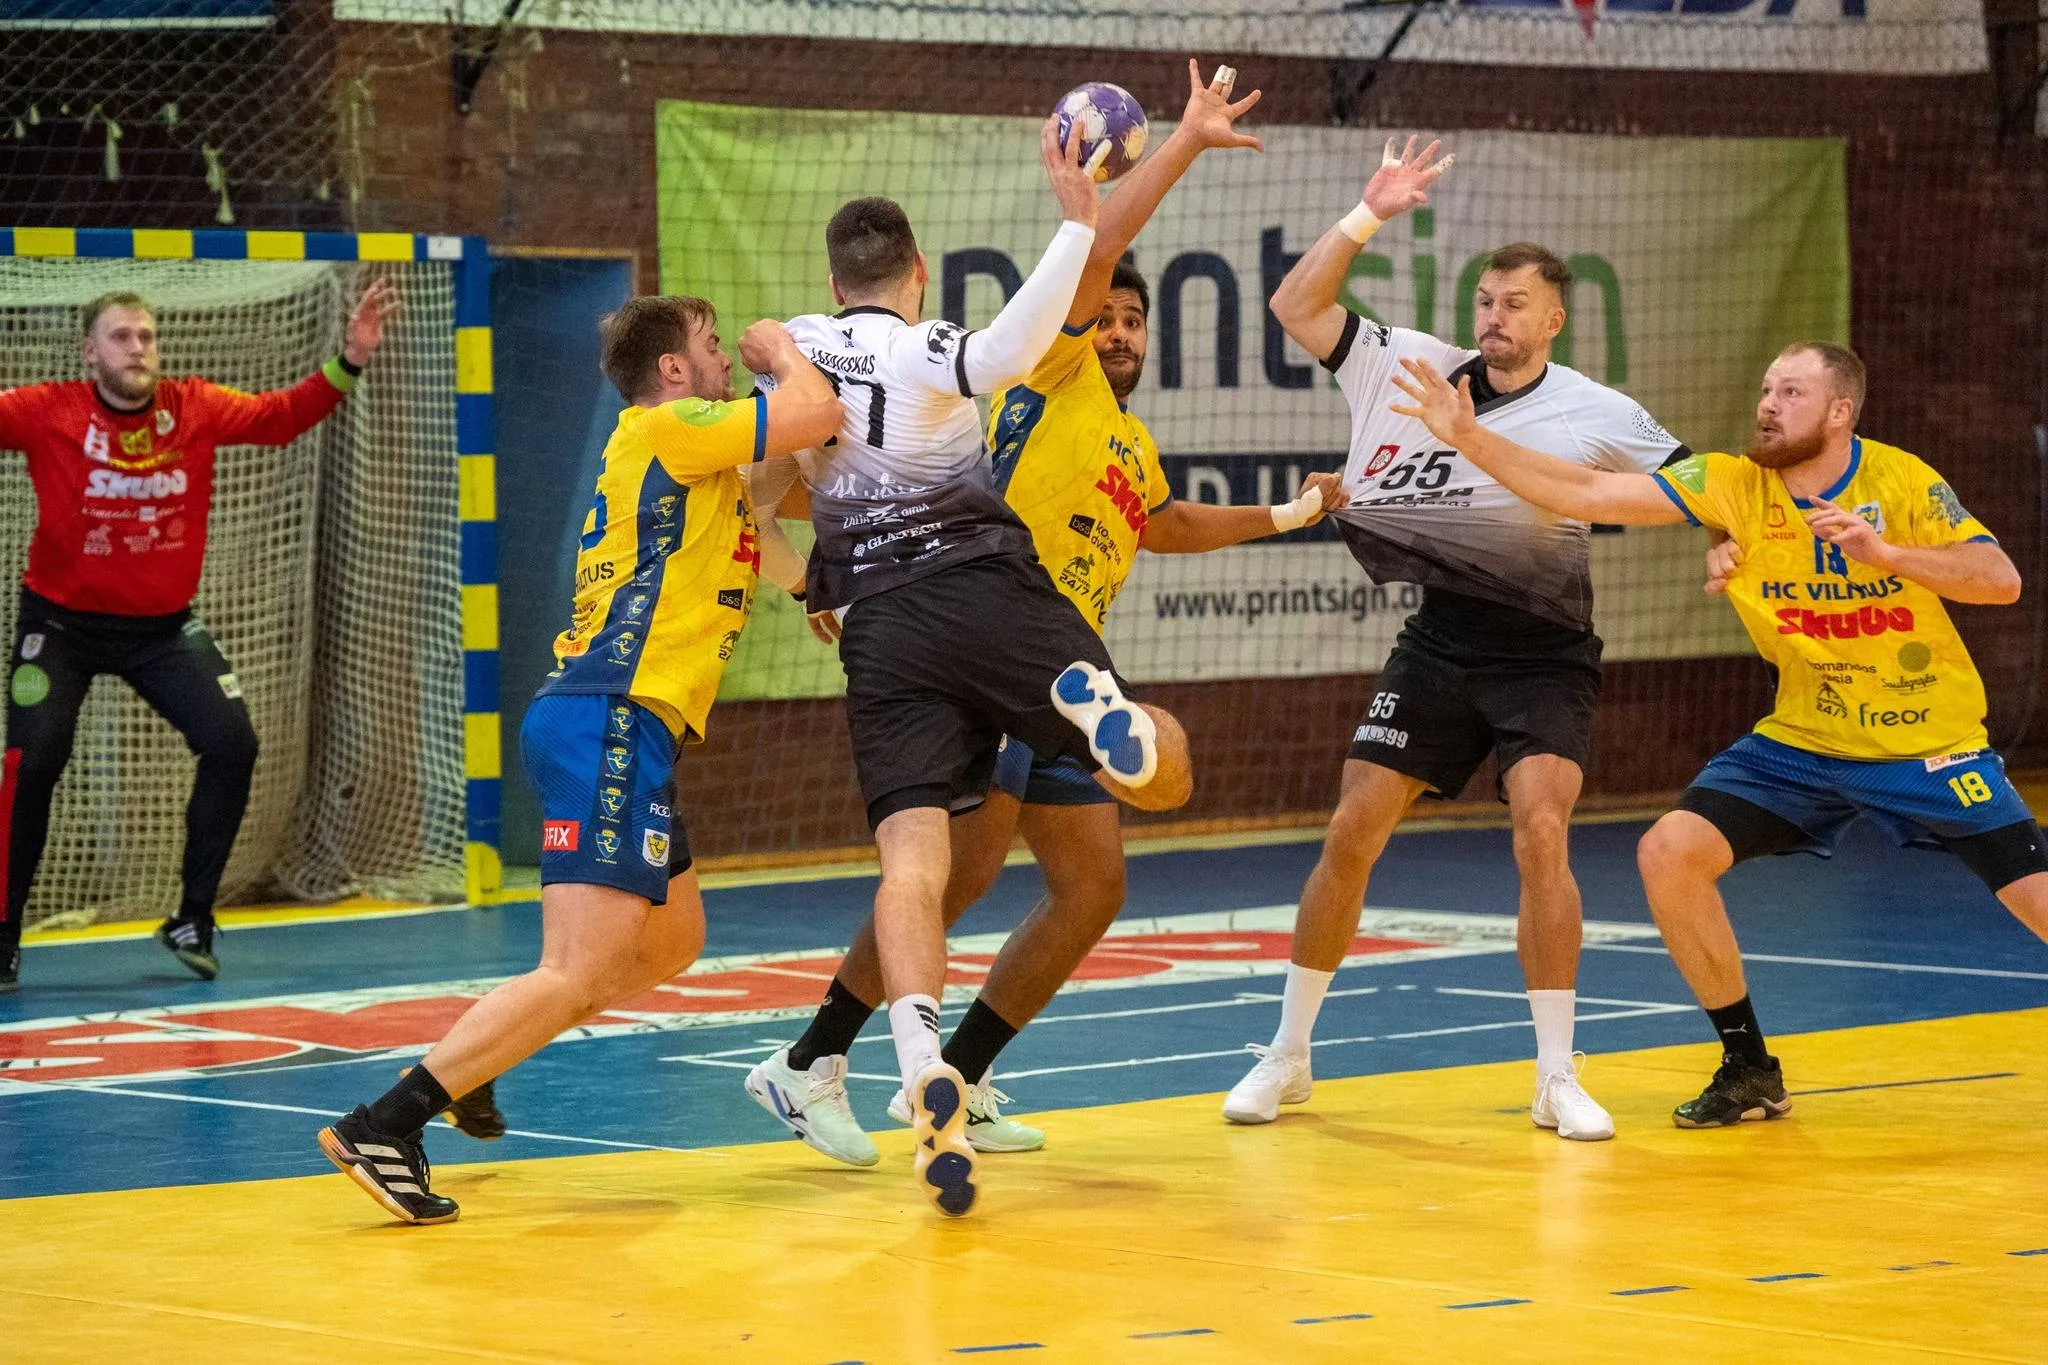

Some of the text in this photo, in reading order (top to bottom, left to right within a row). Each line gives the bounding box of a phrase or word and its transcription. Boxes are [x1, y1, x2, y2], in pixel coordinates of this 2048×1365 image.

[1379, 450, 1458, 490] 55
[1058, 573, 1090, 597] 24/7
[1761, 580, 1798, 600] HC
[720, 592, 741, 608] b&s
[1368, 691, 1401, 719] 55
[1859, 702, 1931, 728] freor
[1947, 771, 1993, 808] 18
